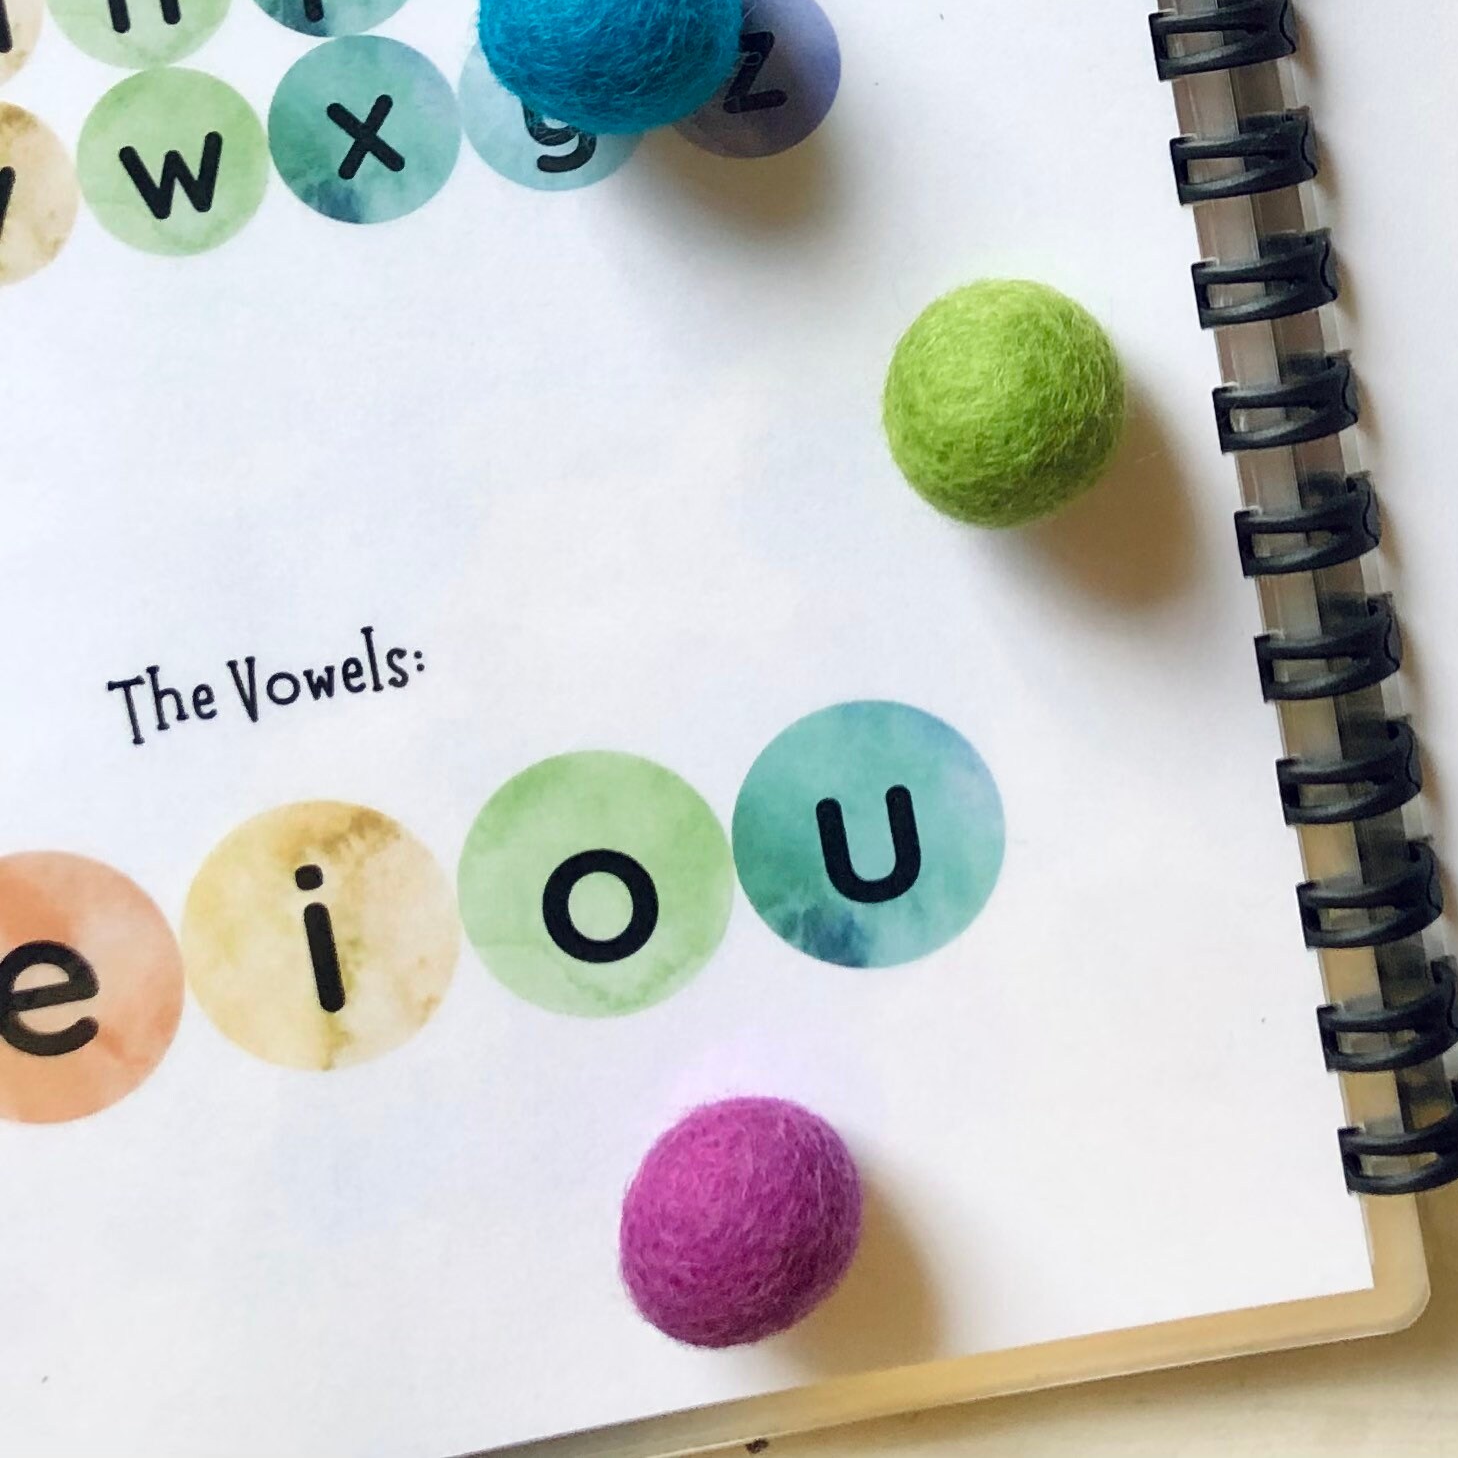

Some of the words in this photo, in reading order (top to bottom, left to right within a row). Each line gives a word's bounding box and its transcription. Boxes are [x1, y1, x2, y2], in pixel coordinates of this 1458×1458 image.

[119, 132, 222, 219] w
[327, 95, 405, 180] x
[723, 31, 788, 114] z
[107, 664, 218, 746] The
[226, 625, 426, 723] Vowels:
[0, 940, 100, 1056] e
[295, 866, 345, 1012] i
[543, 850, 658, 963] o
[816, 786, 921, 904] u
